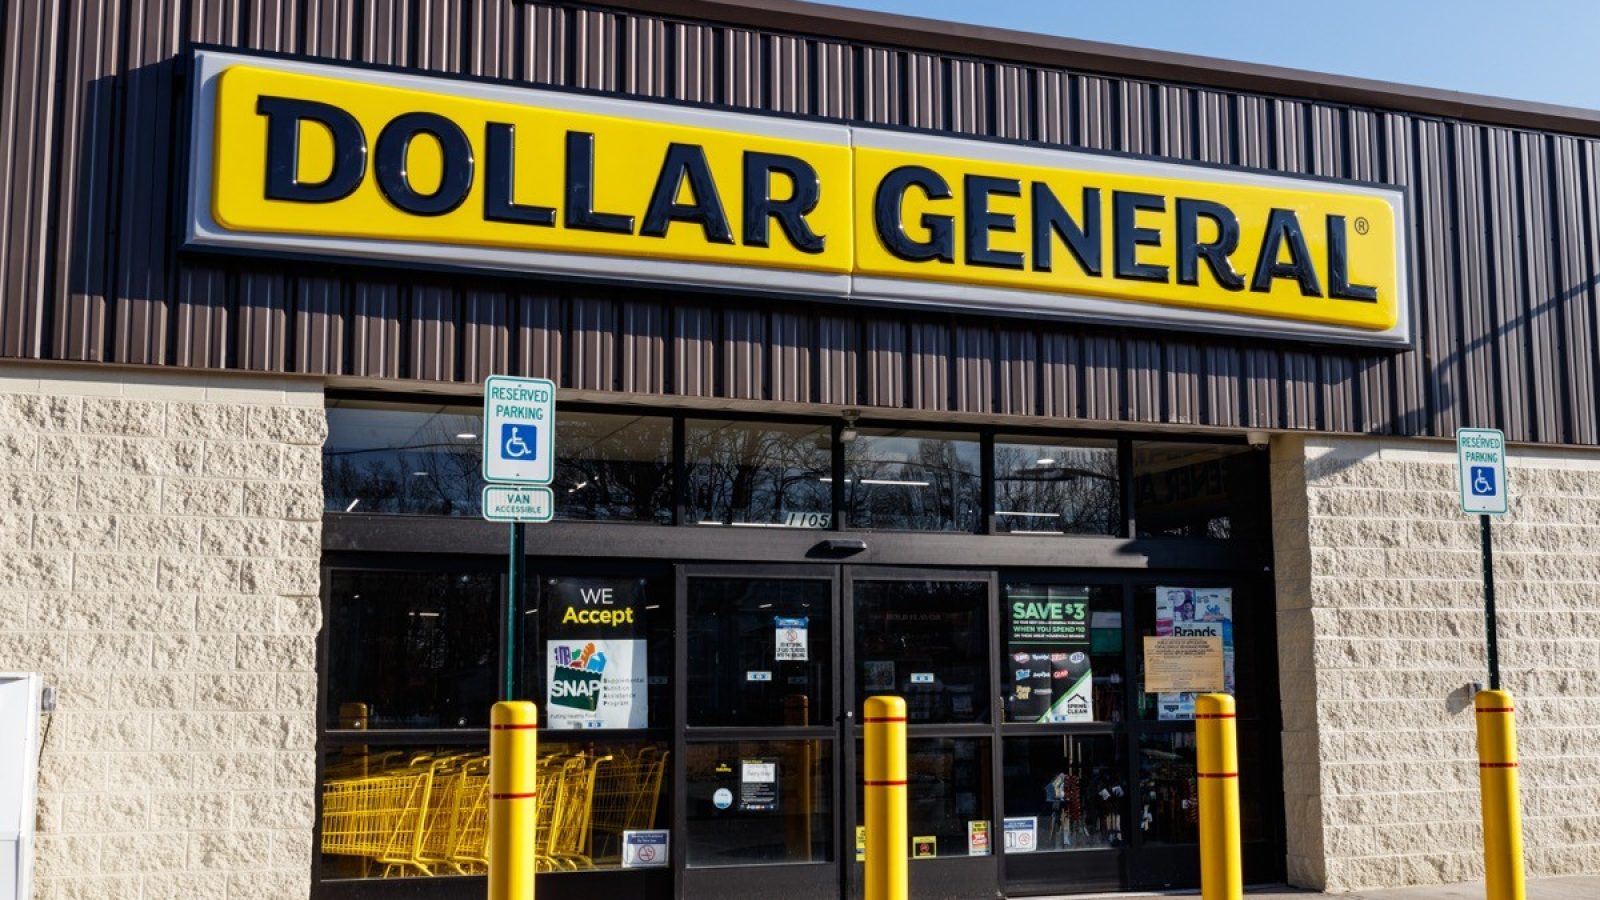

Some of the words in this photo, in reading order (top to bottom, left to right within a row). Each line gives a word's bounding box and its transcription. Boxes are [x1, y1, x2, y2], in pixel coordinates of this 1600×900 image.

[256, 94, 827, 254] DOLLAR
[874, 165, 1379, 303] GENERAL
[491, 387, 549, 403] RESERVED
[495, 404, 544, 420] PARKING
[1461, 436, 1500, 449] RESERVED
[1465, 451, 1498, 463] PARKING
[507, 494, 530, 504] VAN
[495, 505, 542, 514] ACCESSIBLE
[788, 512, 831, 528] 1105
[580, 587, 614, 604] WE
[562, 606, 634, 627] Accept
[1012, 602, 1063, 620] SAVE
[1065, 603, 1086, 620] $3
[1174, 626, 1217, 636] Brands
[551, 679, 601, 697] SNAP
